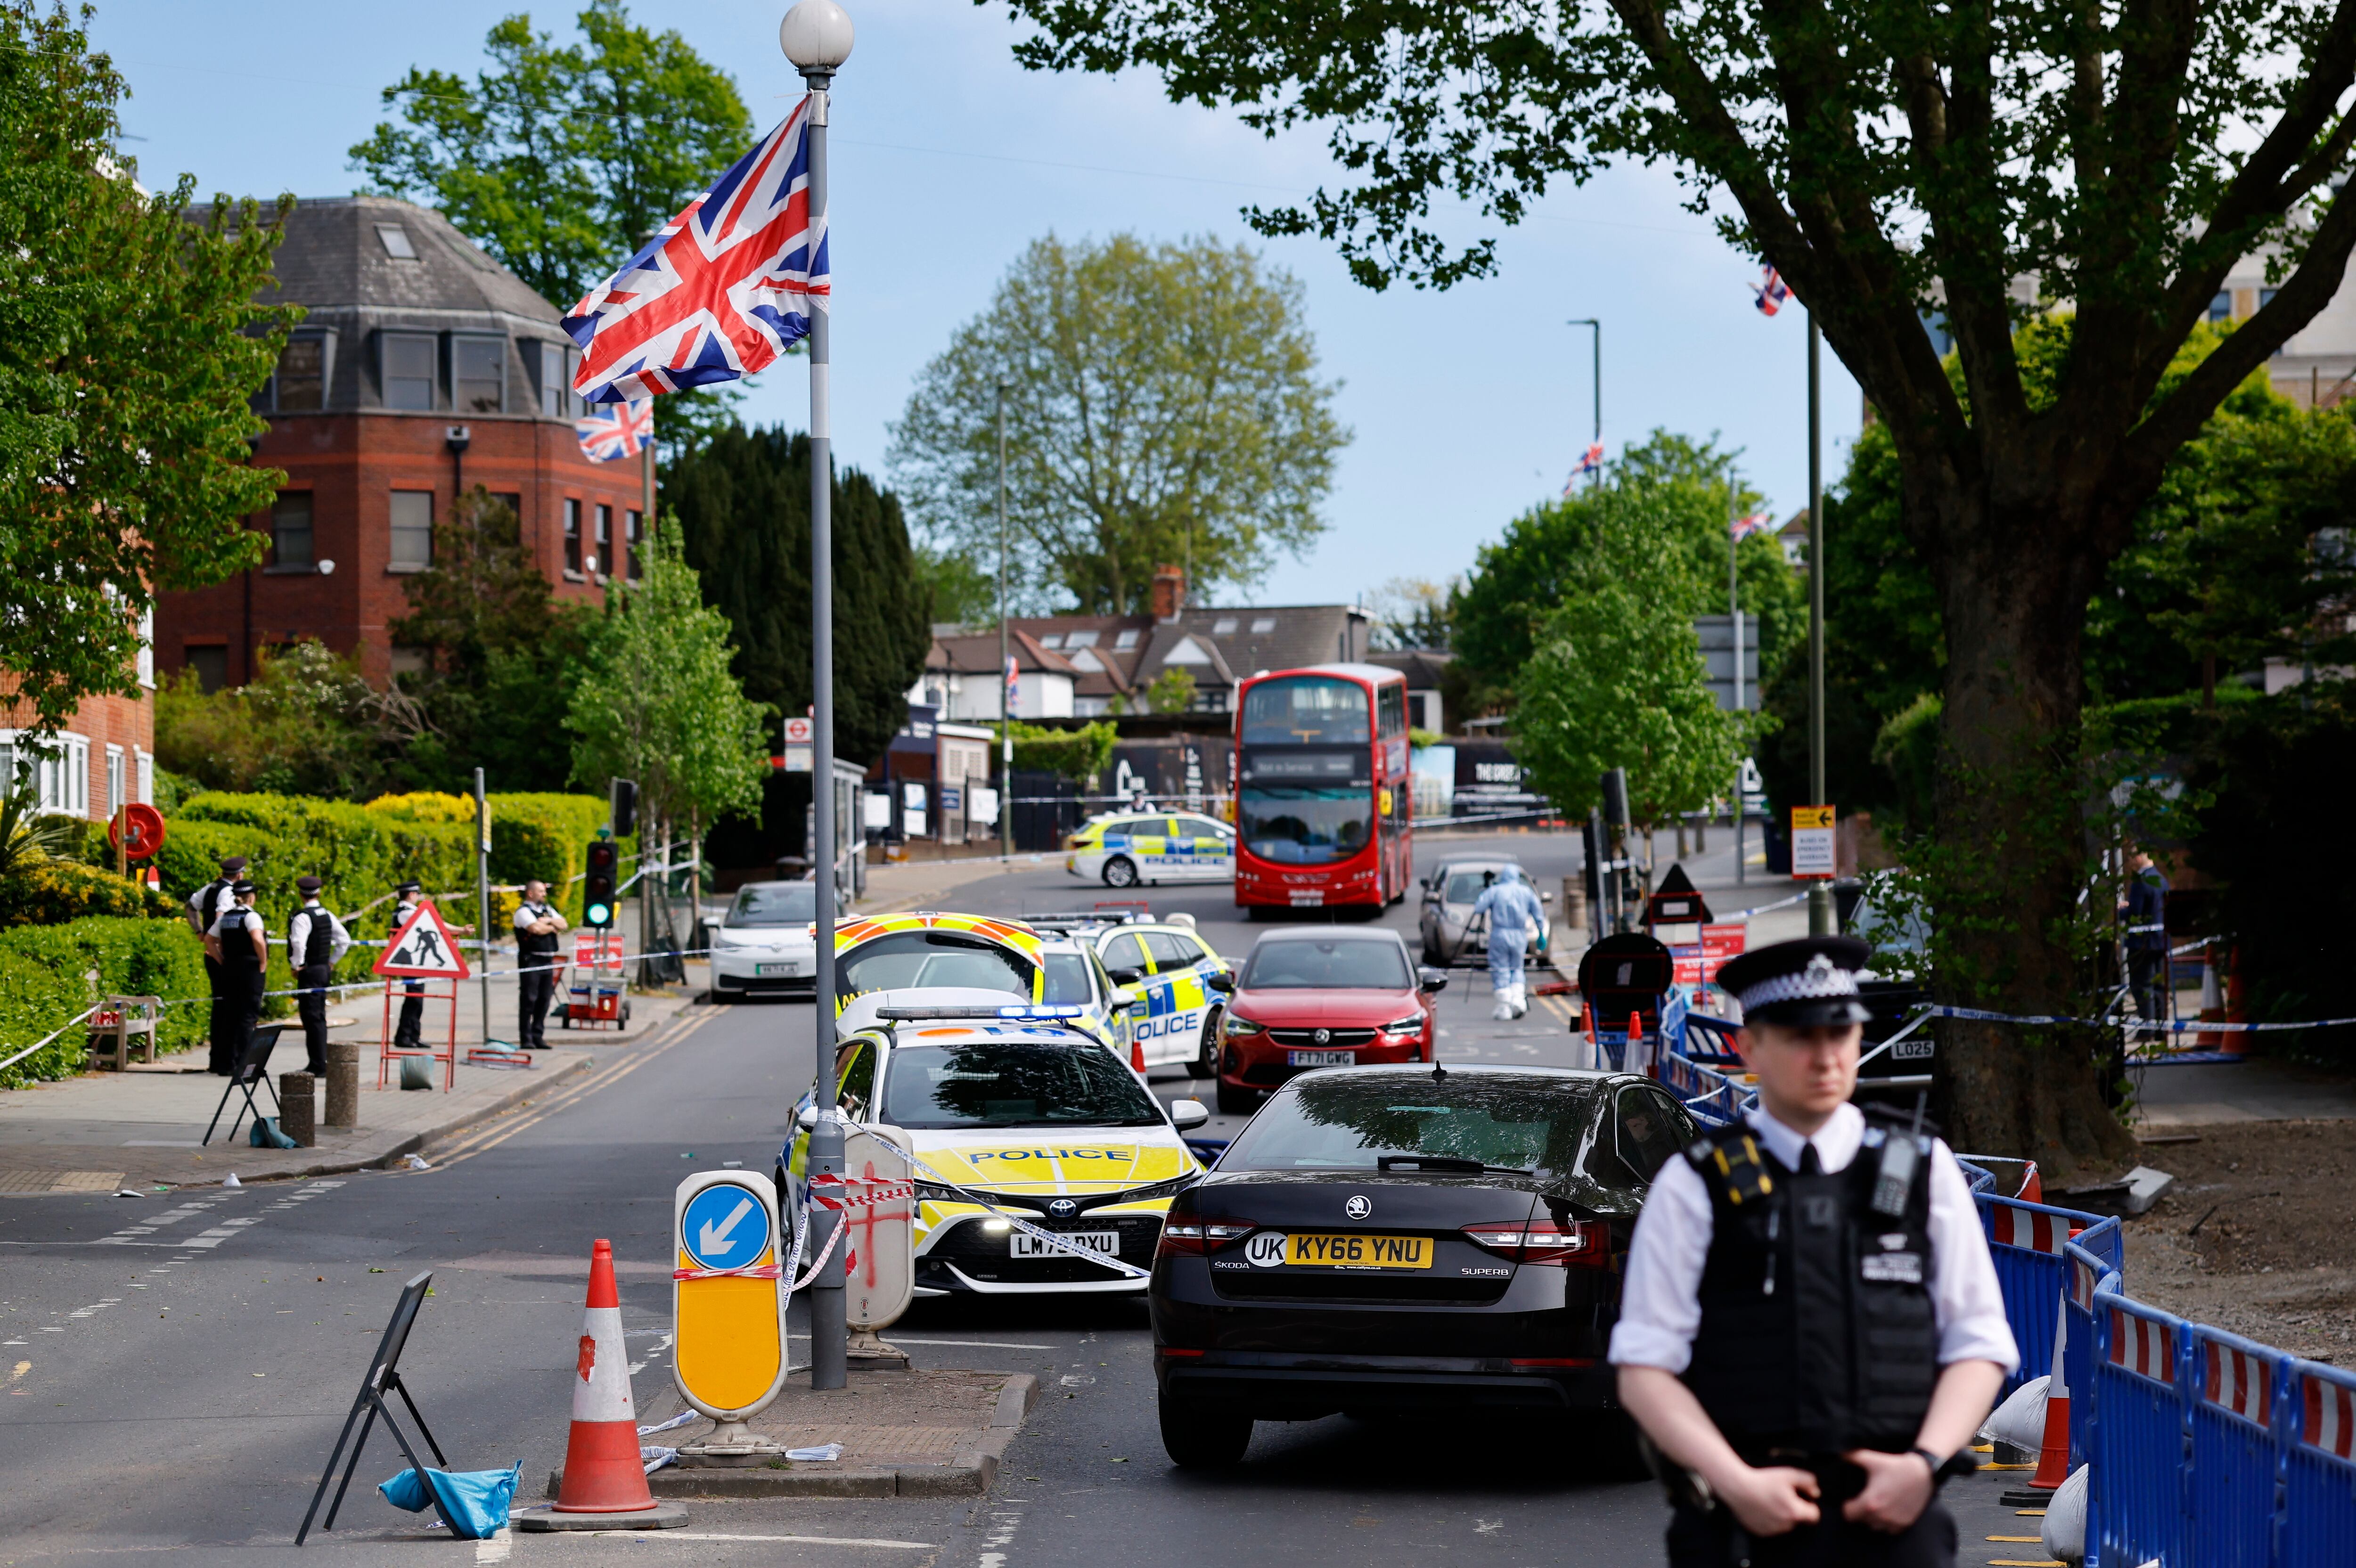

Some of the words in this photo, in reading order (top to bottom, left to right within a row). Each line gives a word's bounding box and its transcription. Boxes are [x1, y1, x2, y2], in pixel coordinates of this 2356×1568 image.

[1145, 856, 1226, 865] POLICE
[1136, 1013, 1198, 1040] OLICE
[1298, 1053, 1324, 1063] FT71
[969, 1150, 1132, 1164] POLICE
[1252, 1238, 1286, 1260] UK
[1296, 1237, 1363, 1260] KY66
[1372, 1238, 1422, 1262] YNU
